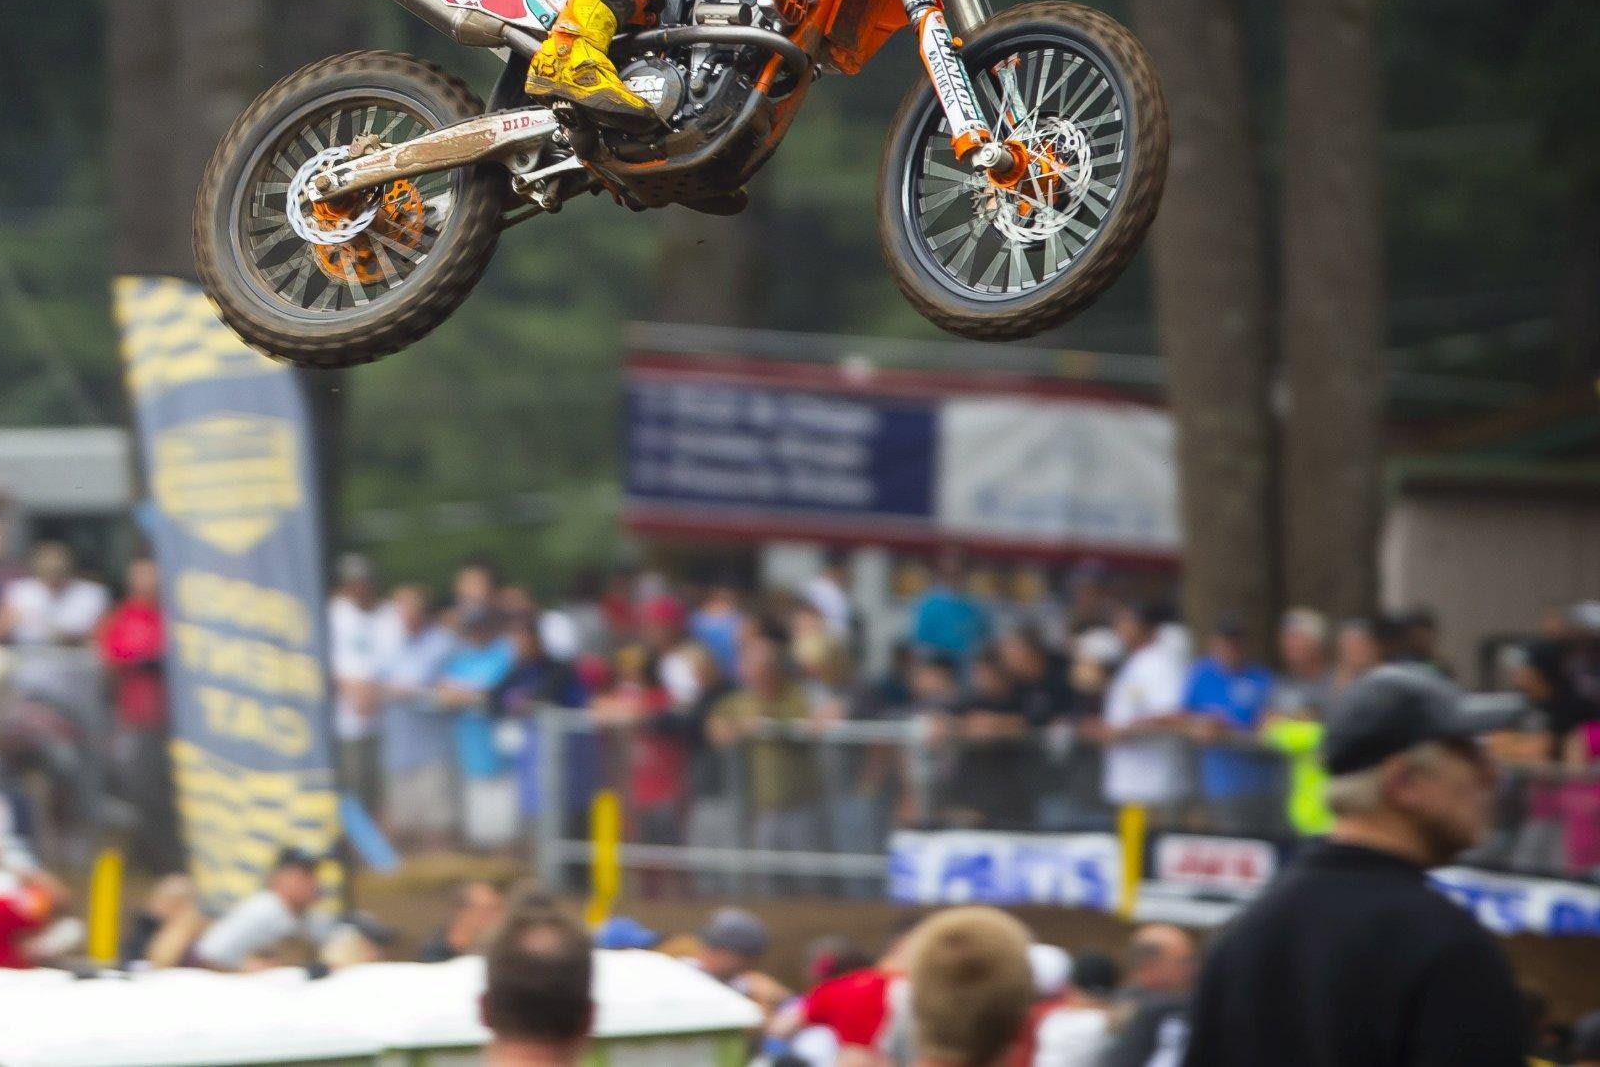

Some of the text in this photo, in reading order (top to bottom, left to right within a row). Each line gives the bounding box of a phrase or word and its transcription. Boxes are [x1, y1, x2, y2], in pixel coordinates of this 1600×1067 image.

[931, 60, 957, 109] ATHENA
[932, 29, 981, 122] DUNLOP
[502, 116, 530, 133] DID
